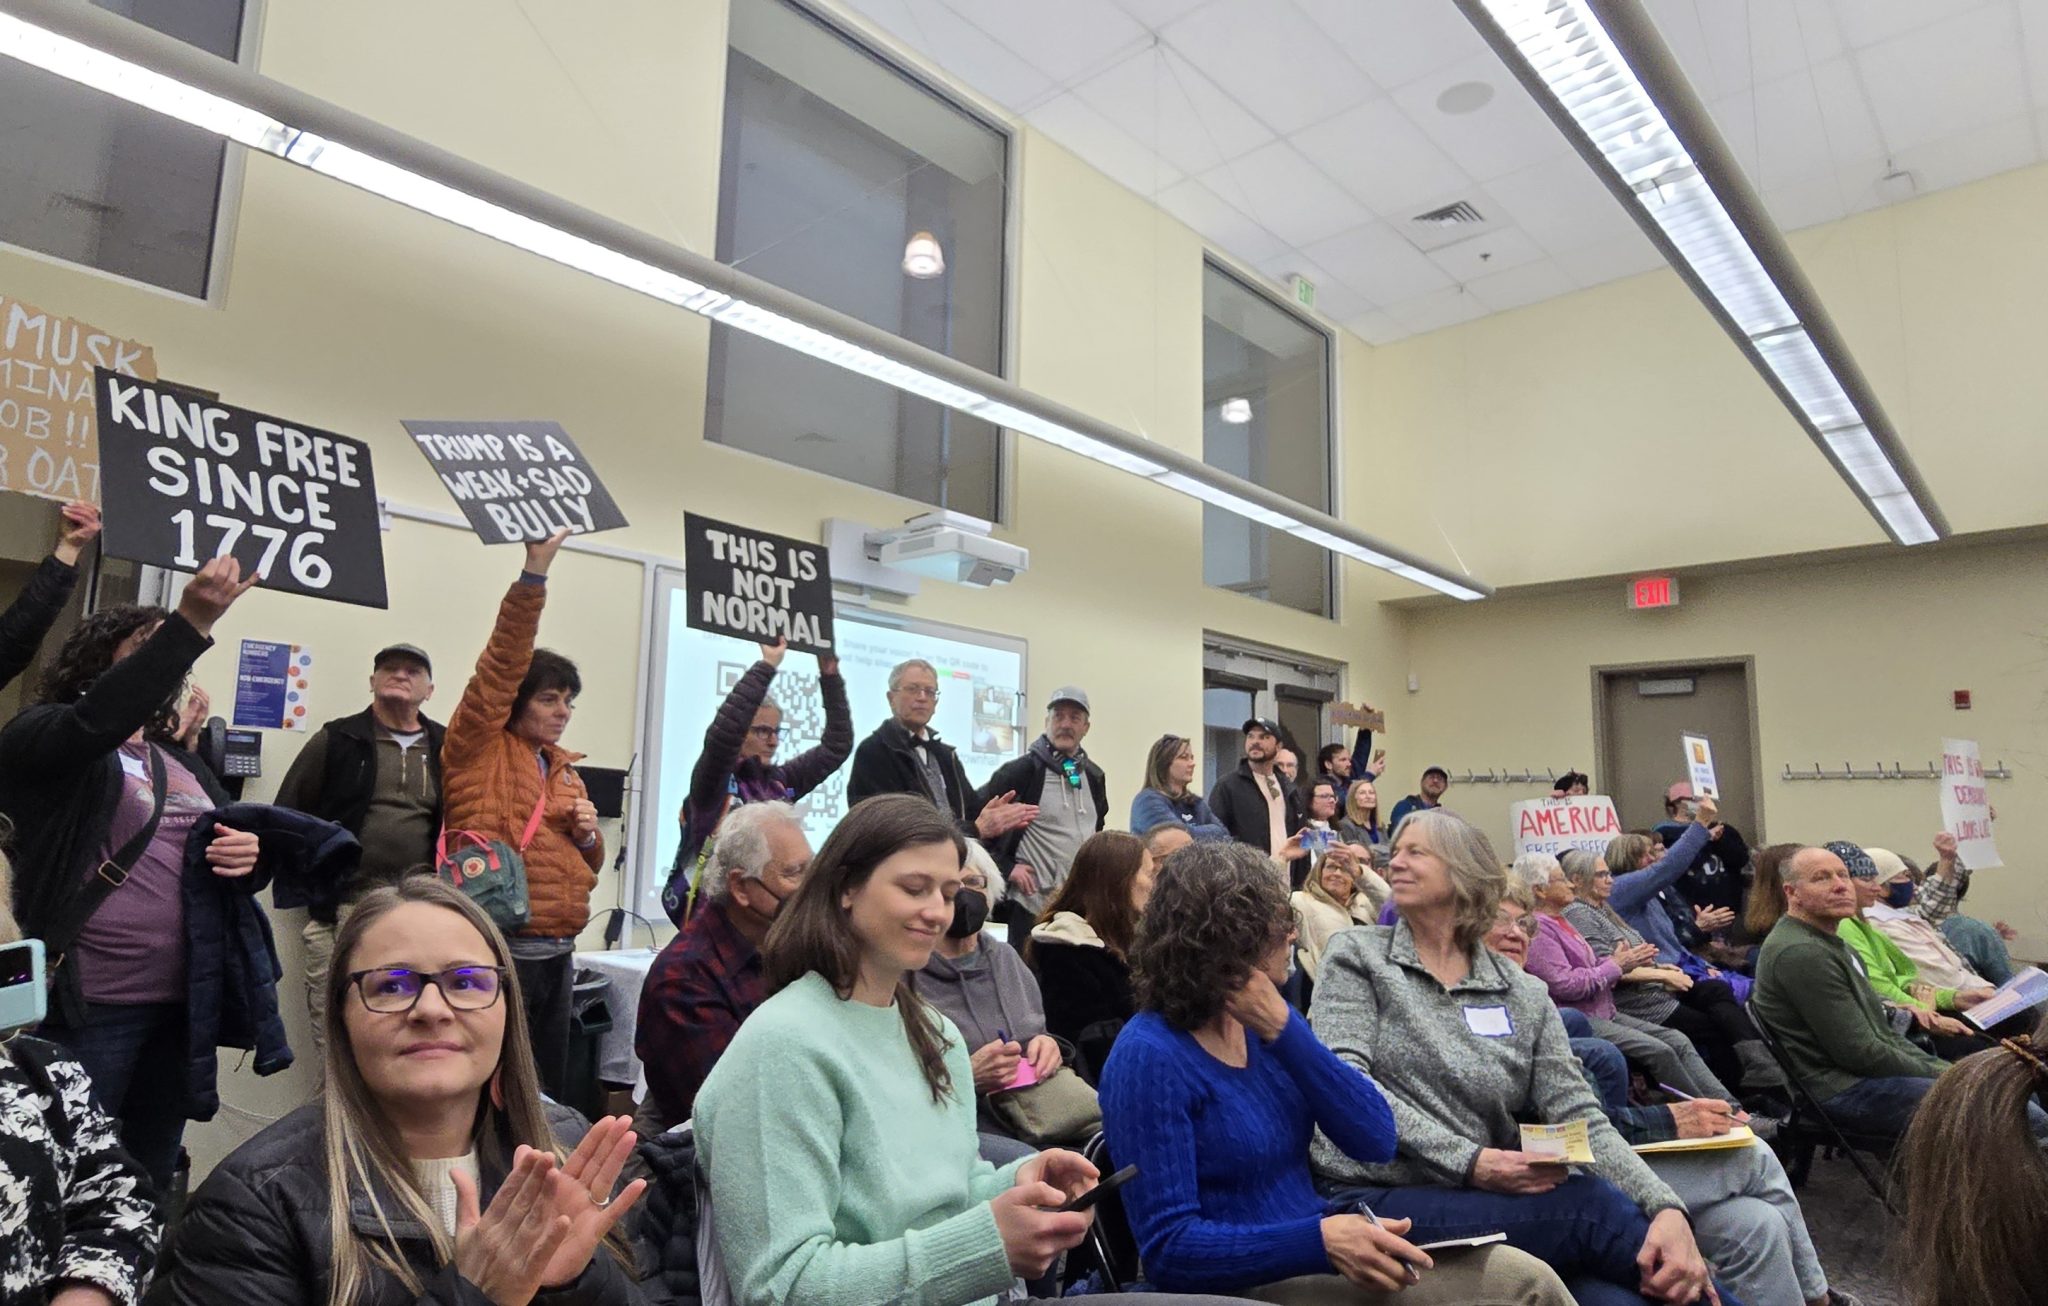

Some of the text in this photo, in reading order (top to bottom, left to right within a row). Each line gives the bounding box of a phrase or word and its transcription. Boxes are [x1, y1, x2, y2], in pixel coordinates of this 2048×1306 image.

[6, 303, 143, 378] MUSK
[108, 378, 361, 487] KING FREE
[415, 433, 575, 462] TRUMP IS A
[146, 446, 337, 531] SINCE
[484, 496, 596, 541] BULLY
[171, 509, 333, 589] 1776
[705, 528, 818, 581] THIS IS
[733, 567, 795, 609] NOT
[1635, 580, 1670, 606] EXIT
[702, 590, 831, 648] NORMAL
[1520, 805, 1622, 838] AMERICA
[1541, 798, 1573, 807] THIS IS
[1525, 841, 1559, 854] FREE
